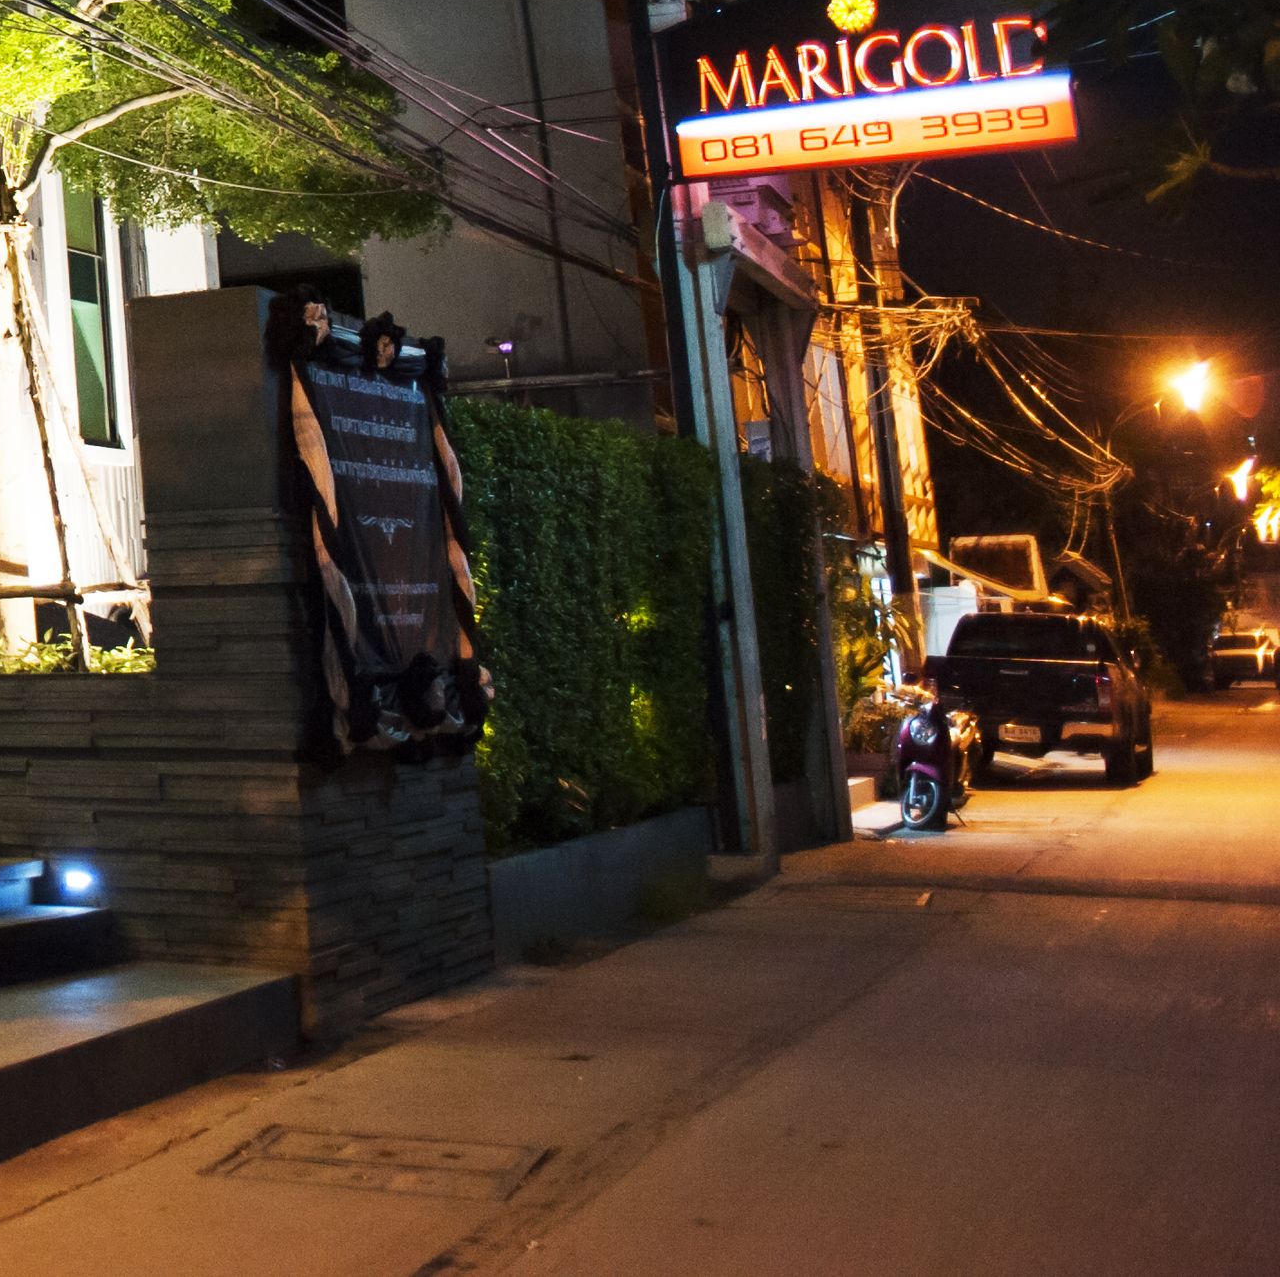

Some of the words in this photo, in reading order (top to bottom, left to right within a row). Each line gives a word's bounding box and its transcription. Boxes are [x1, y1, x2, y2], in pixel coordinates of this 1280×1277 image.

[696, 16, 1046, 112] MARIGOLD
[700, 132, 774, 163] 081
[799, 120, 894, 152] 649
[920, 104, 1049, 140] 3939
